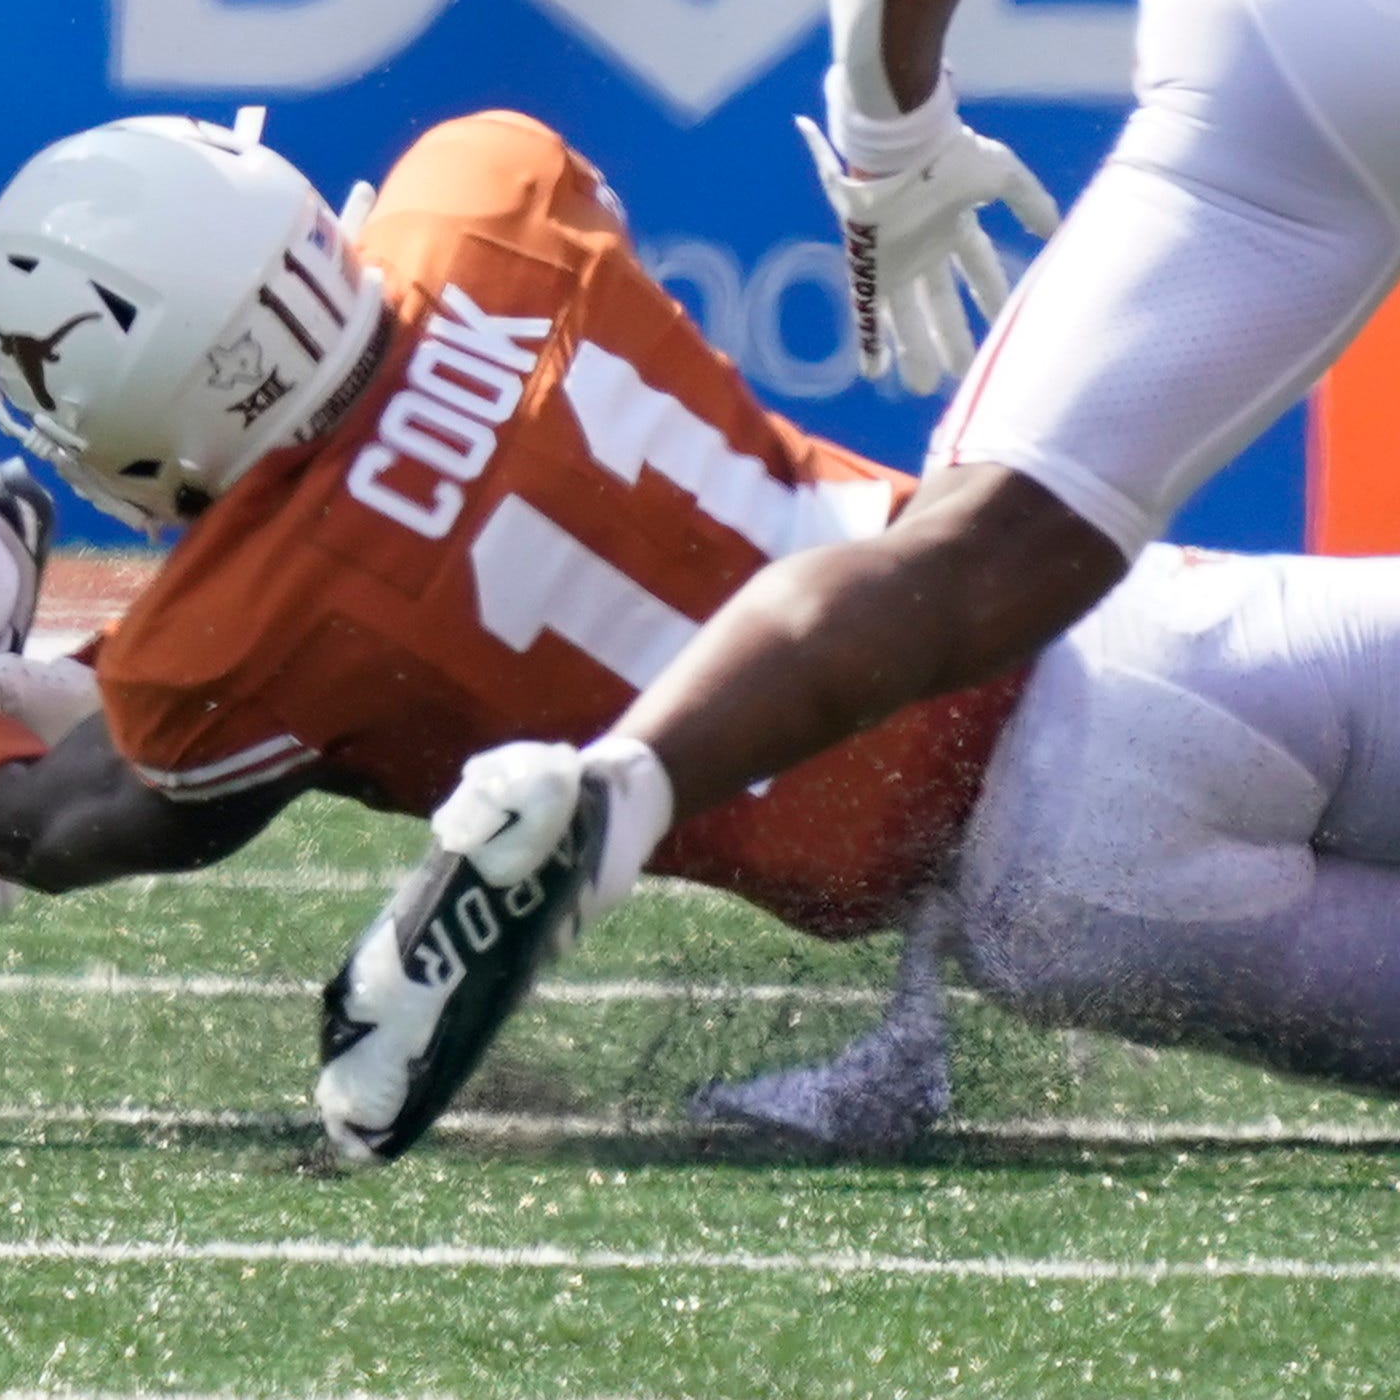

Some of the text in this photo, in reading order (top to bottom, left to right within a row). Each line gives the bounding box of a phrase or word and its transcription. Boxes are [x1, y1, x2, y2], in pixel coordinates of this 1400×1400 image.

[259, 249, 347, 364] 11
[347, 283, 553, 540] COOK
[470, 339, 891, 692] 11
